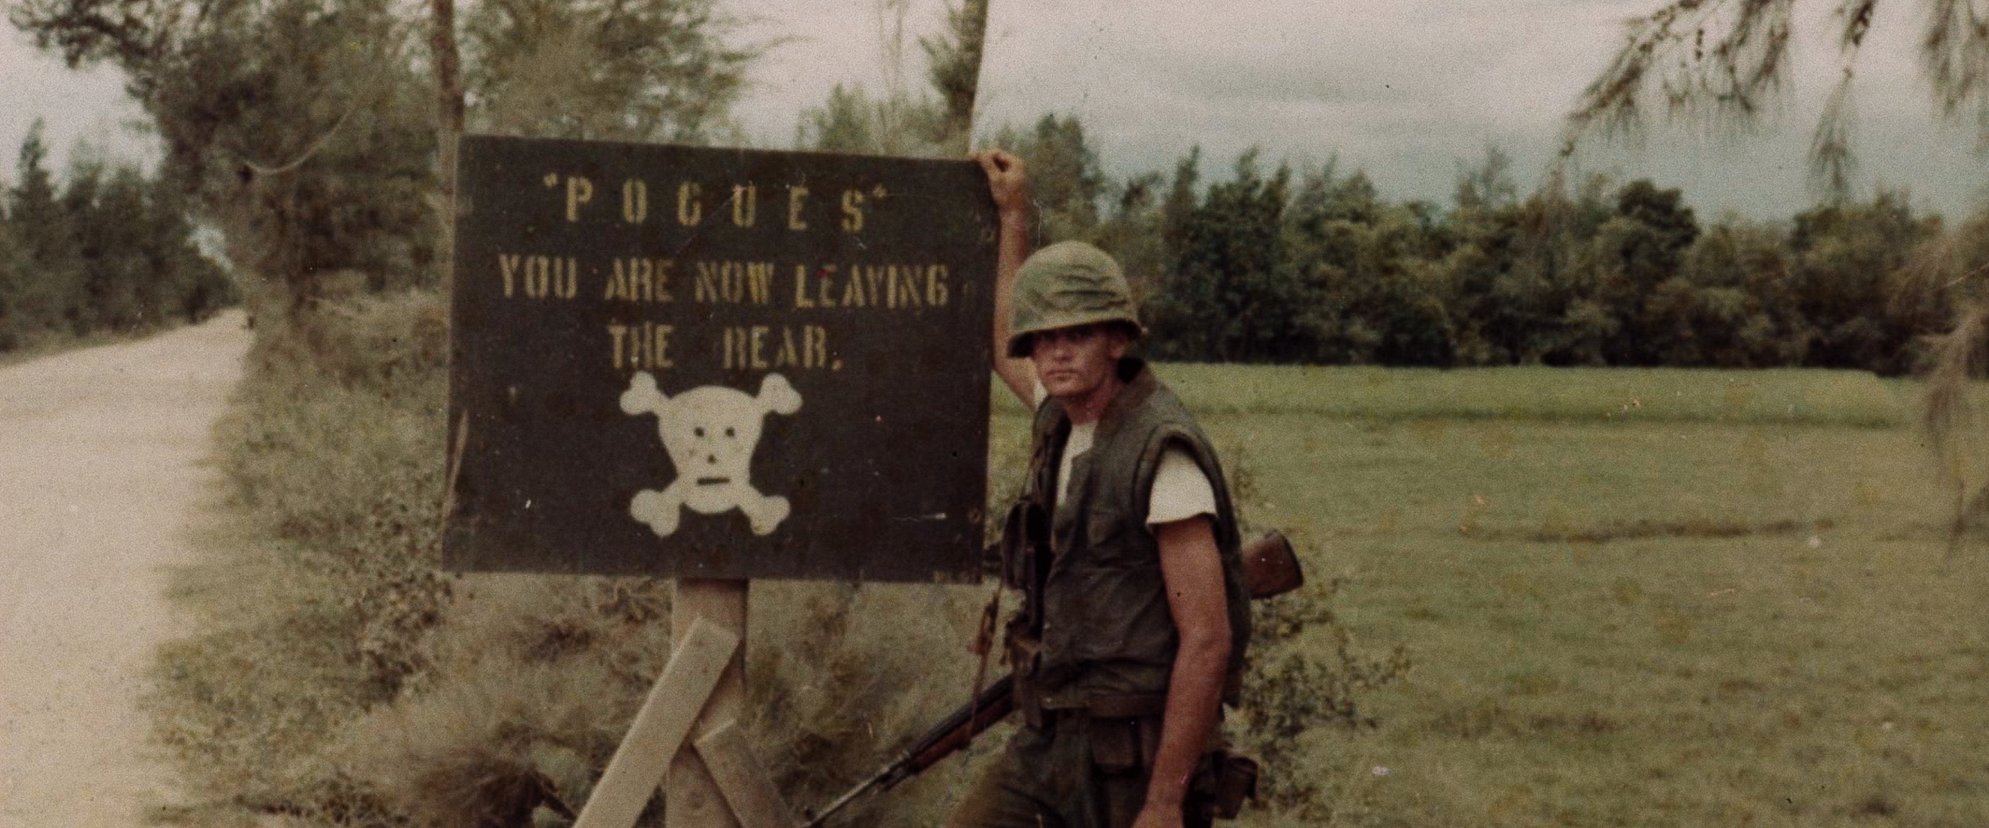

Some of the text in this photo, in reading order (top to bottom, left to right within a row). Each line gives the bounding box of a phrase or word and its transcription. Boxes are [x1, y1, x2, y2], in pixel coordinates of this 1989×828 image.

[500, 253, 949, 308] YOU ARE NOW LEAVING
[607, 324, 844, 371] THE REAR.
